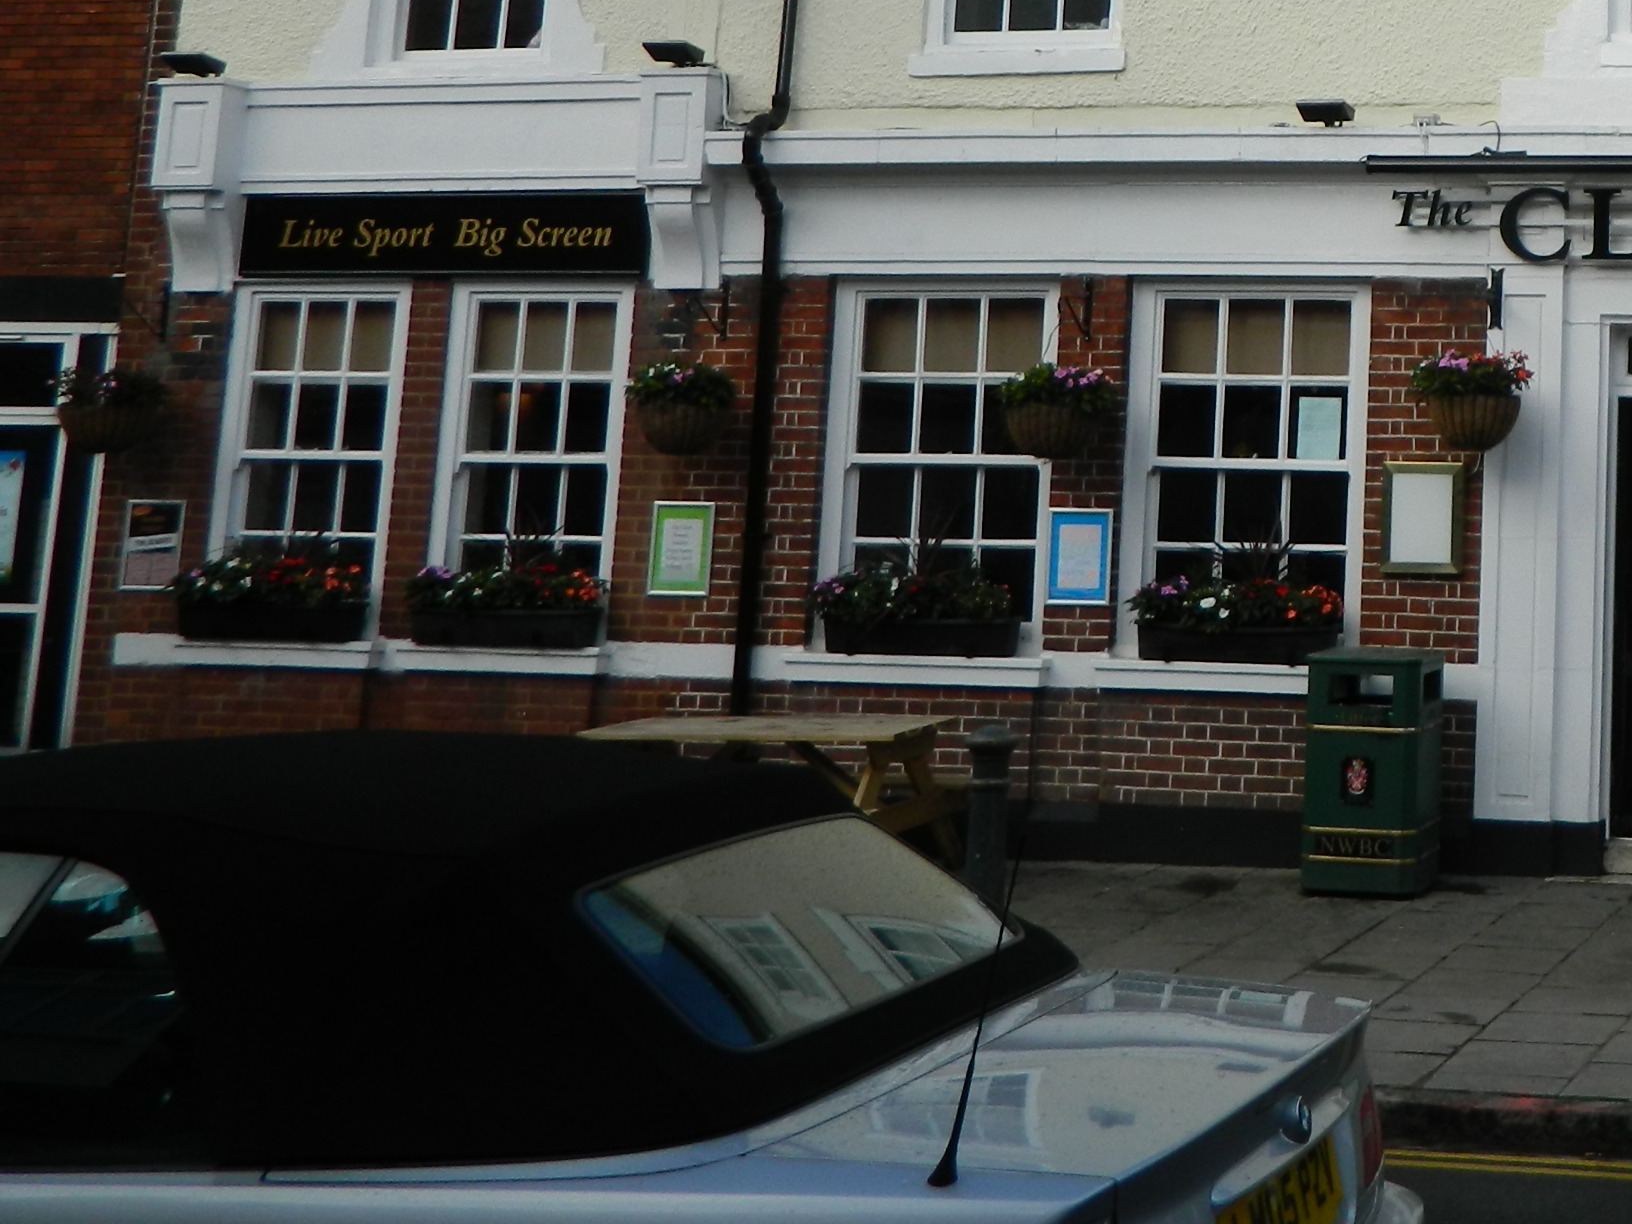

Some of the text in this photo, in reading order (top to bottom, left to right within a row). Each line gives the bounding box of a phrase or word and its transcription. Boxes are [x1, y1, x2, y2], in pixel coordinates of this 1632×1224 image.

[1391, 188, 1474, 228] The
[278, 217, 613, 257] Live Sport Big Screen
[1320, 837, 1392, 857] NWBC
